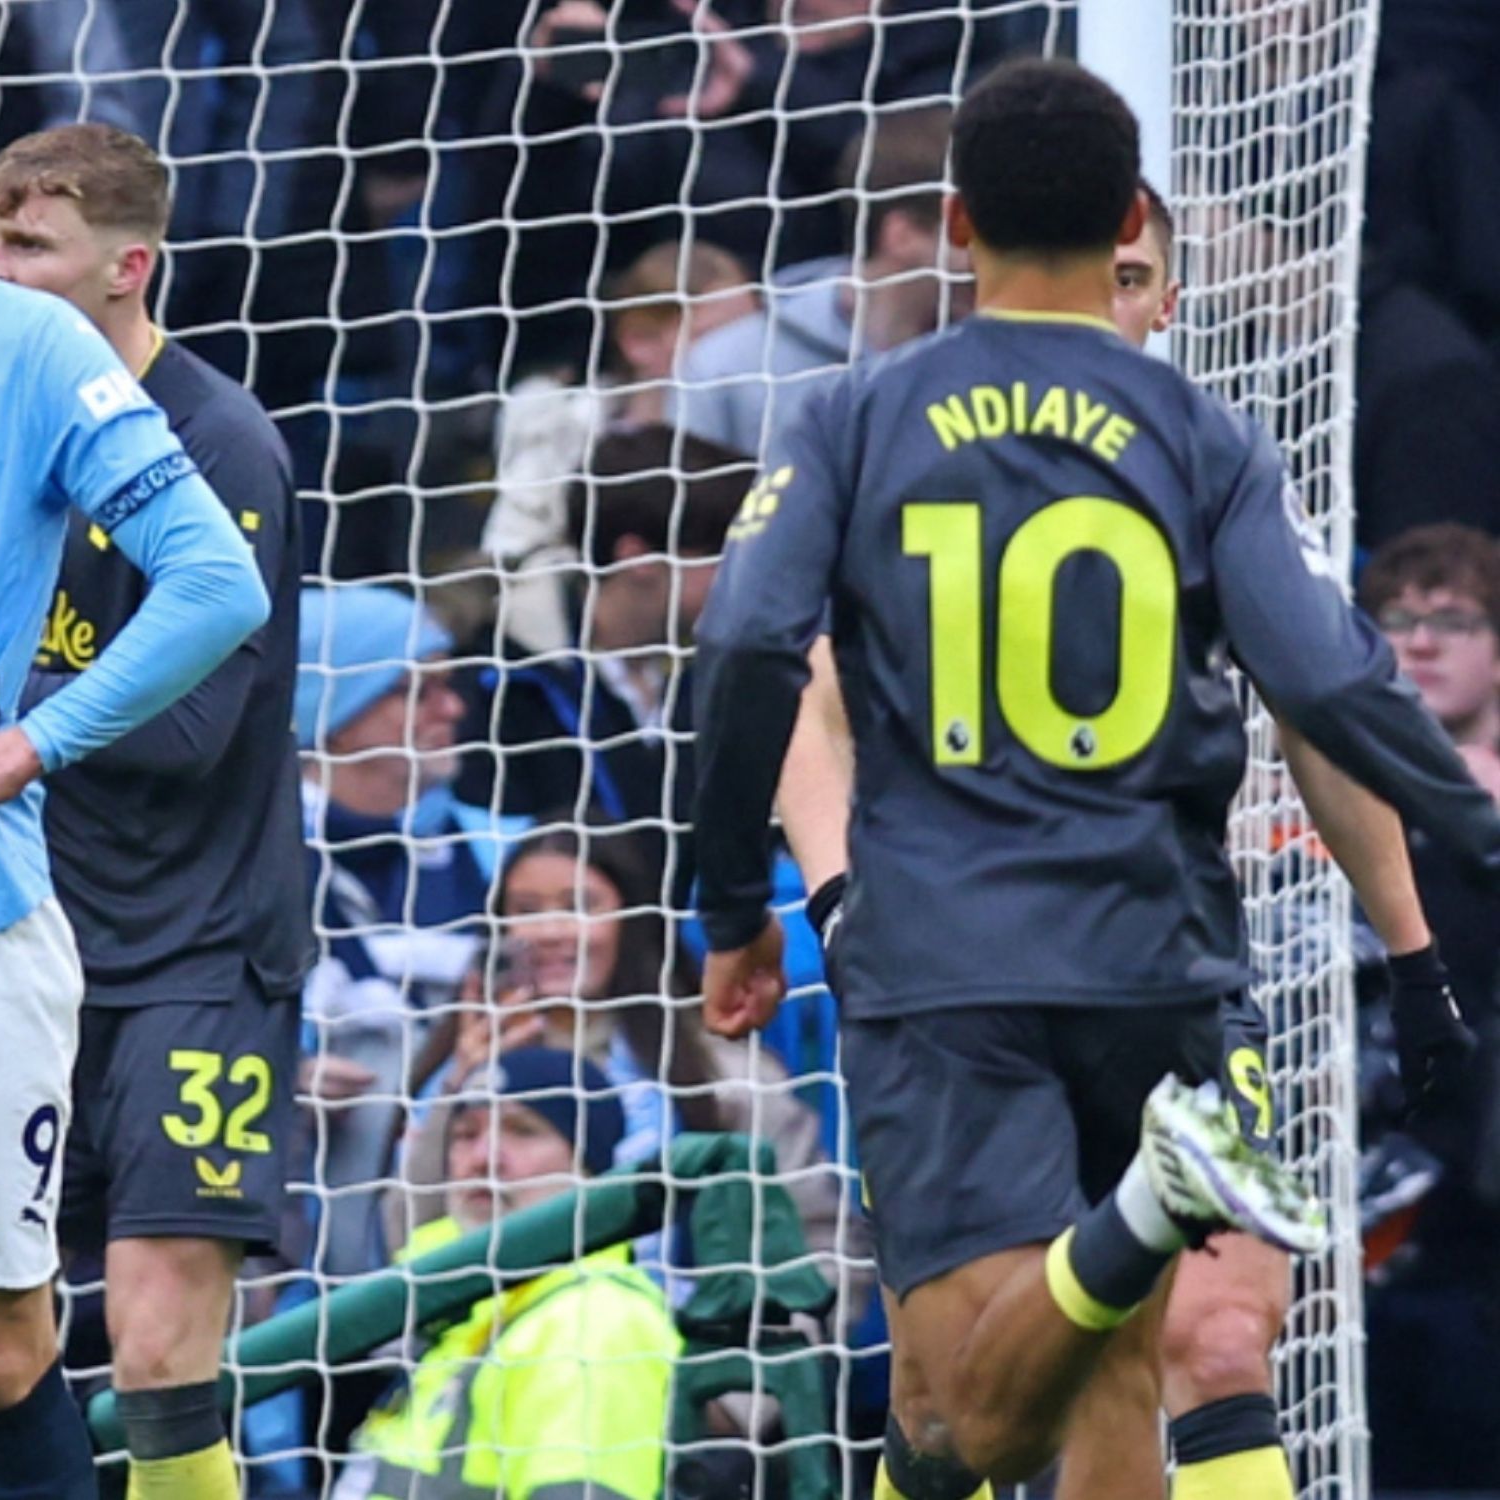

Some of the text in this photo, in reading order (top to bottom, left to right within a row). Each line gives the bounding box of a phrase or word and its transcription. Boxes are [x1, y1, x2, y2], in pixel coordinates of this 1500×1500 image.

[926, 381, 1138, 463] NDIAYE
[902, 495, 1177, 770] 10
[161, 1049, 272, 1153] 32
[22, 1103, 59, 1201] 9
